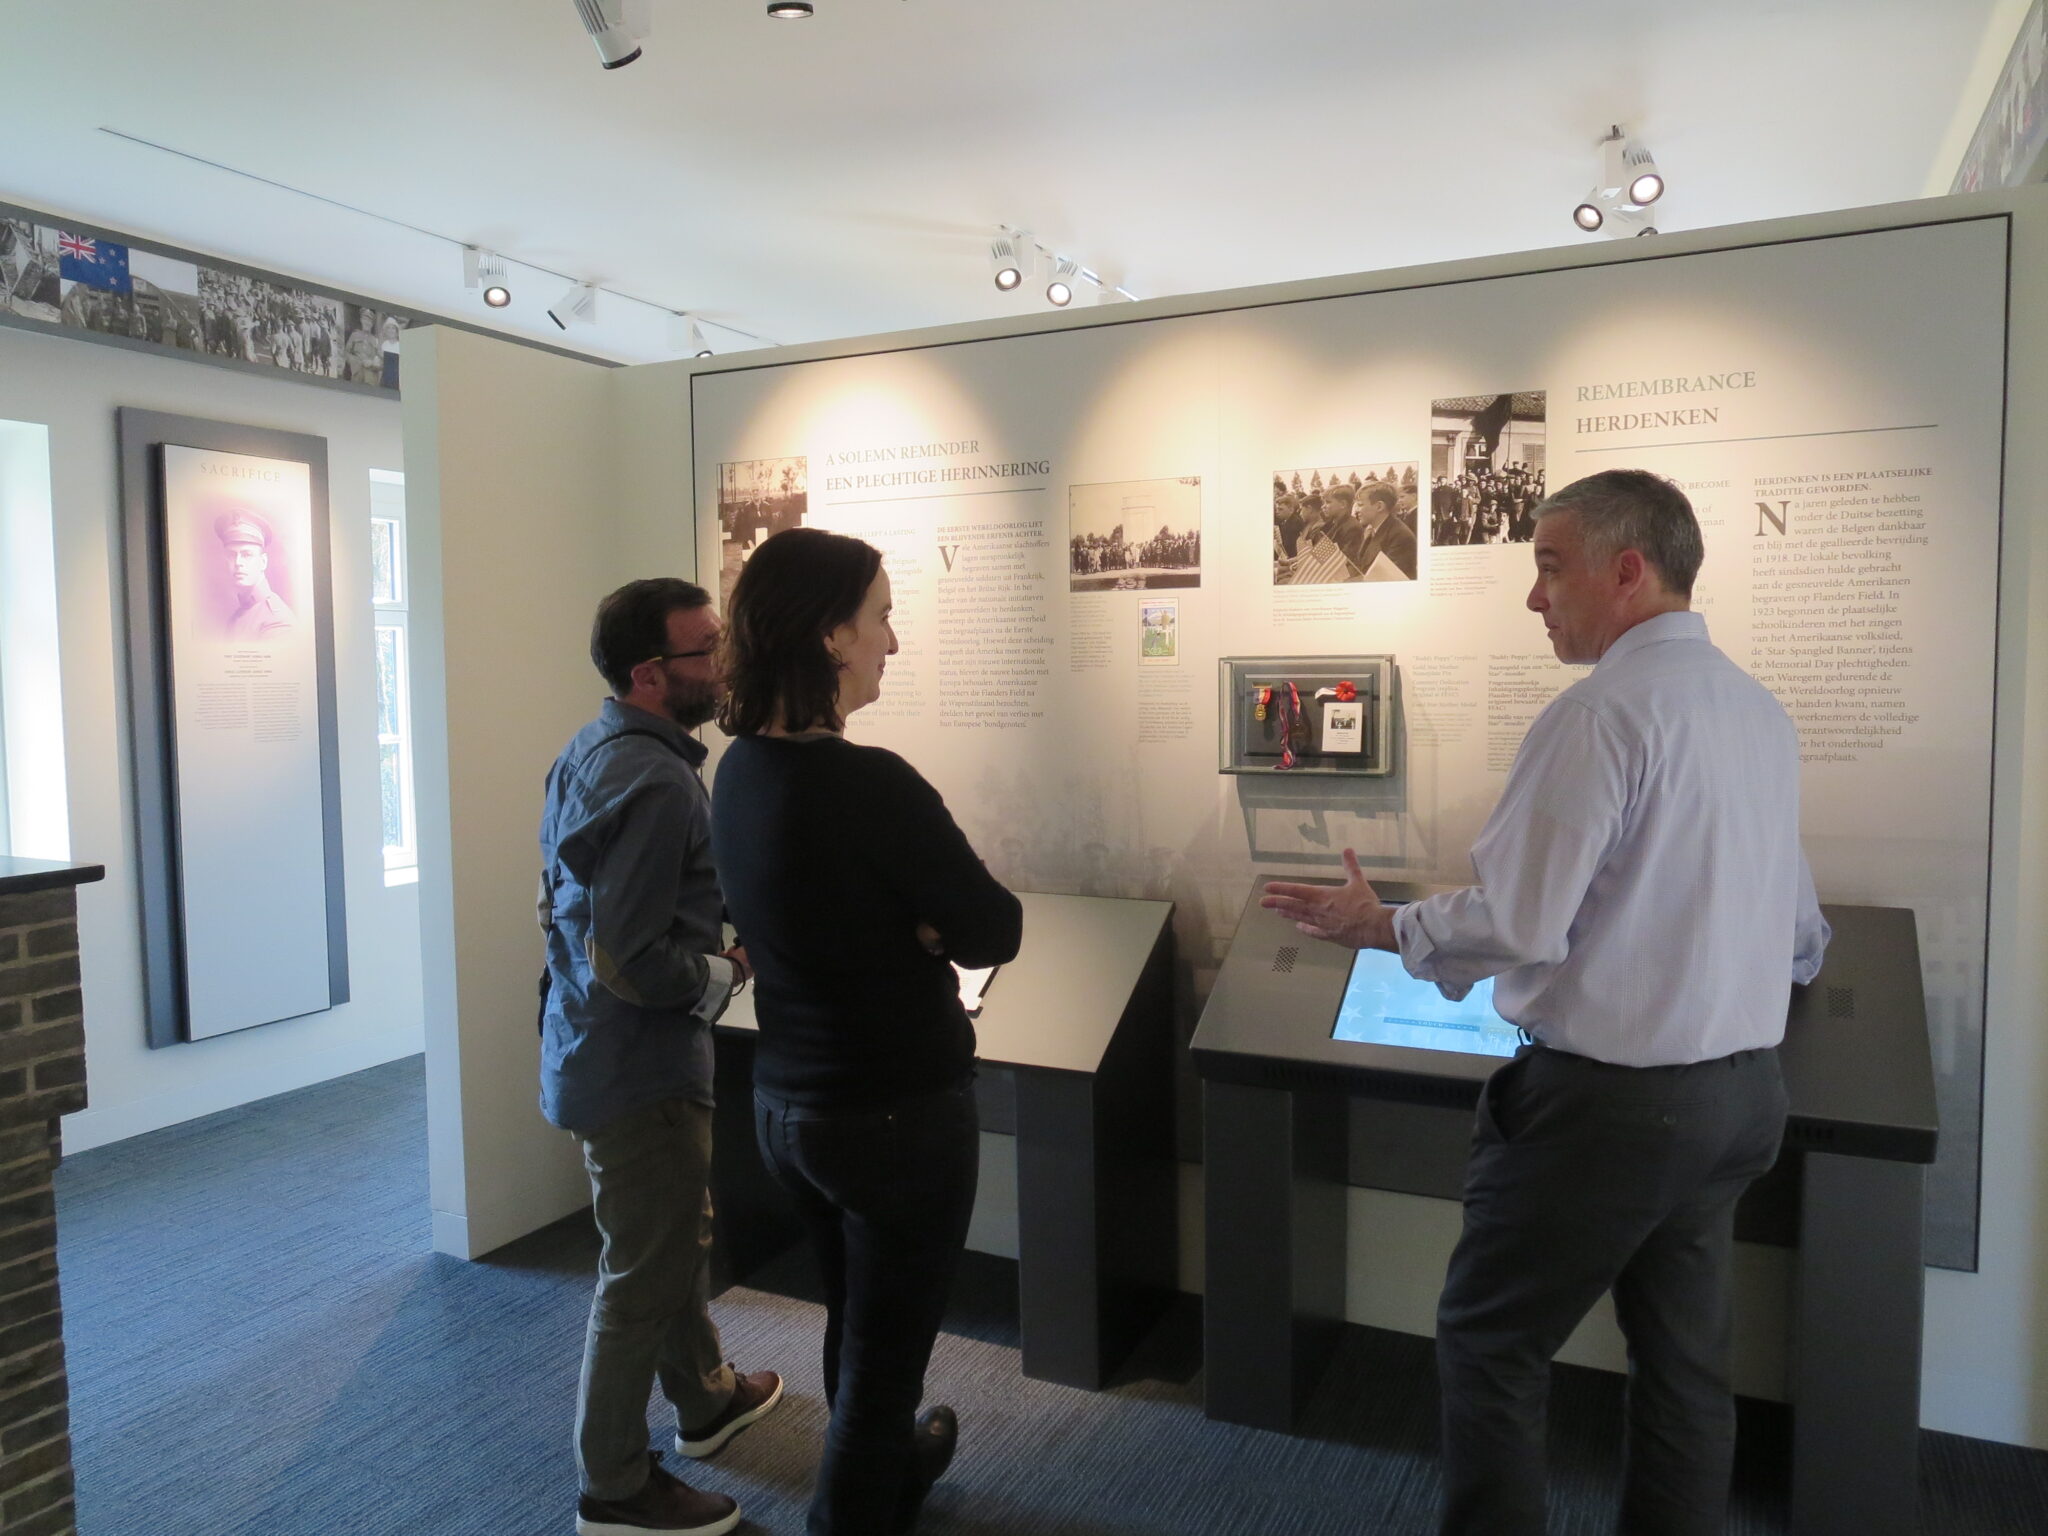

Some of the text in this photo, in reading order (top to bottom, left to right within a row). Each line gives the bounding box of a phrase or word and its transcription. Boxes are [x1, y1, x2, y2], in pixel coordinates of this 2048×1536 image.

[1577, 372, 1756, 401] REMEMBRANCE
[1576, 408, 1720, 433] HERDENKEN
[826, 440, 980, 466] A SOLEMN REMINDER
[201, 463, 280, 481] SACRIFICE
[826, 460, 1050, 491] EEN PLECHTIGE HERINNERING
[1754, 468, 1932, 486] HERDENKEN IS EEN PLAATSELIJKE
[1689, 481, 1730, 489] BECOME
[1754, 483, 1871, 497] TRADITIE GEWORDEN.
[1803, 499, 1827, 510] jaren
[1830, 498, 1868, 508] geleden
[1883, 494, 1920, 503] hebben
[1702, 504, 1712, 513] of
[1794, 508, 1923, 521] onder de Duitse bezetting
[972, 523, 1027, 531] WERELDOORLOG
[1794, 522, 1926, 535] waren de Belgen dankbaar
[1806, 540, 1817, 548] de
[1820, 536, 1873, 549] geallieerde
[1876, 535, 1928, 545] bevrijding
[1794, 554, 1807, 562] De
[1810, 552, 1840, 560] lokale
[1842, 550, 1892, 561] bevolking
[1752, 563, 1901, 576] heeft sindsdien hulde gebracht
[1752, 577, 1910, 591] aan de gesneuvelde Amerikanen
[1752, 594, 1795, 604] begraven
[1798, 595, 1809, 604] op
[1813, 592, 1855, 601] Flanders
[1889, 591, 1899, 599] In
[1753, 603, 1897, 618] 1923 begonnen de plaatselijke
[1752, 619, 1901, 629] schoolkinderen met het zingen
[1771, 633, 1785, 642] het
[1789, 633, 1852, 642] Amerikaanse
[1751, 647, 1762, 656] de
[1879, 645, 1912, 655] tijdens
[1751, 661, 1762, 669] de
[1765, 660, 1811, 668] Memorial
[1815, 659, 1834, 670] Day
[1778, 672, 1822, 683] Waregem
[1825, 672, 1878, 683] gedurende
[1880, 672, 1892, 680] de
[1790, 685, 1855, 696] Wereldoorlog
[1858, 686, 1901, 696] opnieuw
[1796, 698, 1831, 708] handen
[1871, 700, 1905, 708] namen
[1797, 712, 1919, 723] werknemers de volledige
[1797, 725, 1901, 737] verantwoordelijkheid
[1810, 740, 1825, 748] het
[1828, 739, 1883, 748] onderhoud
[1799, 753, 1858, 763] egraafplaats.
